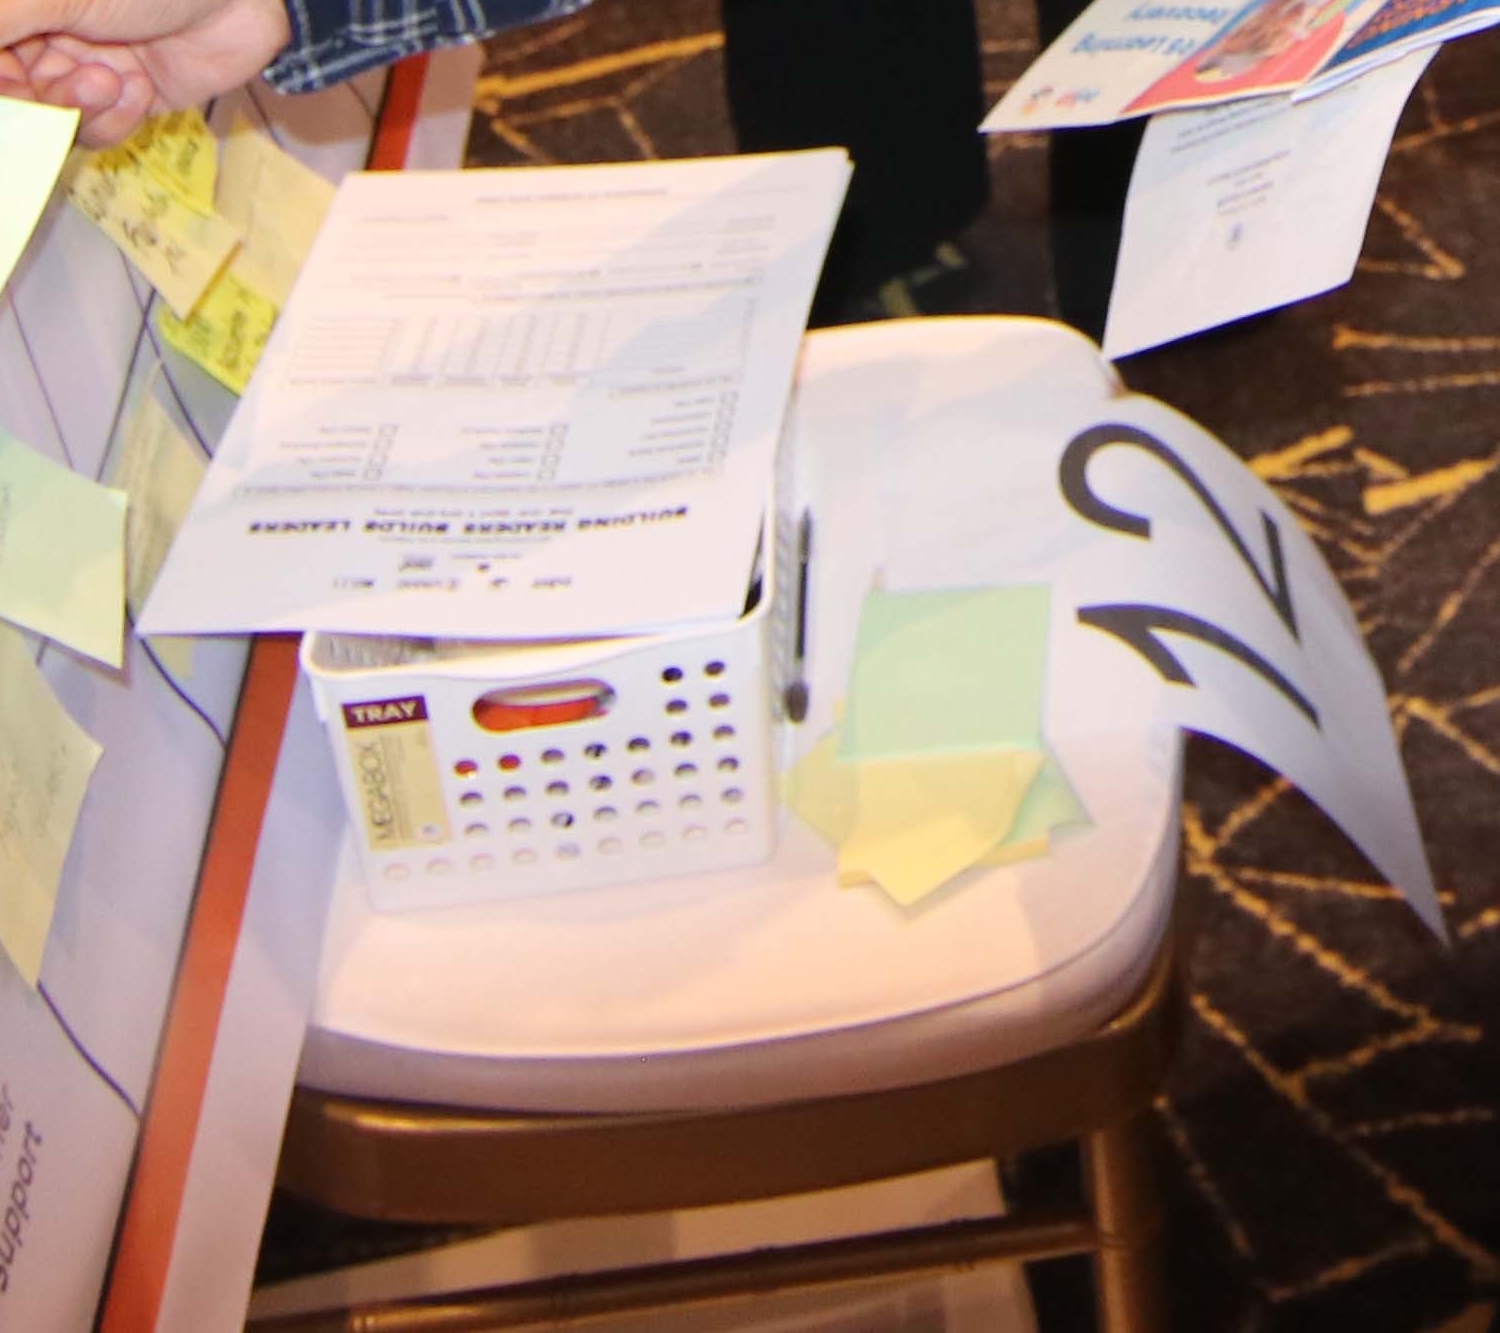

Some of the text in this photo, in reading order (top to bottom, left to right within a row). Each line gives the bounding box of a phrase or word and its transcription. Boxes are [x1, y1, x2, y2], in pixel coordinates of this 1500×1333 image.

[248, 506, 689, 534] BUILDING READERS BUILDS LEADERS
[1056, 421, 1322, 733] 12
[352, 701, 417, 723] TRAY
